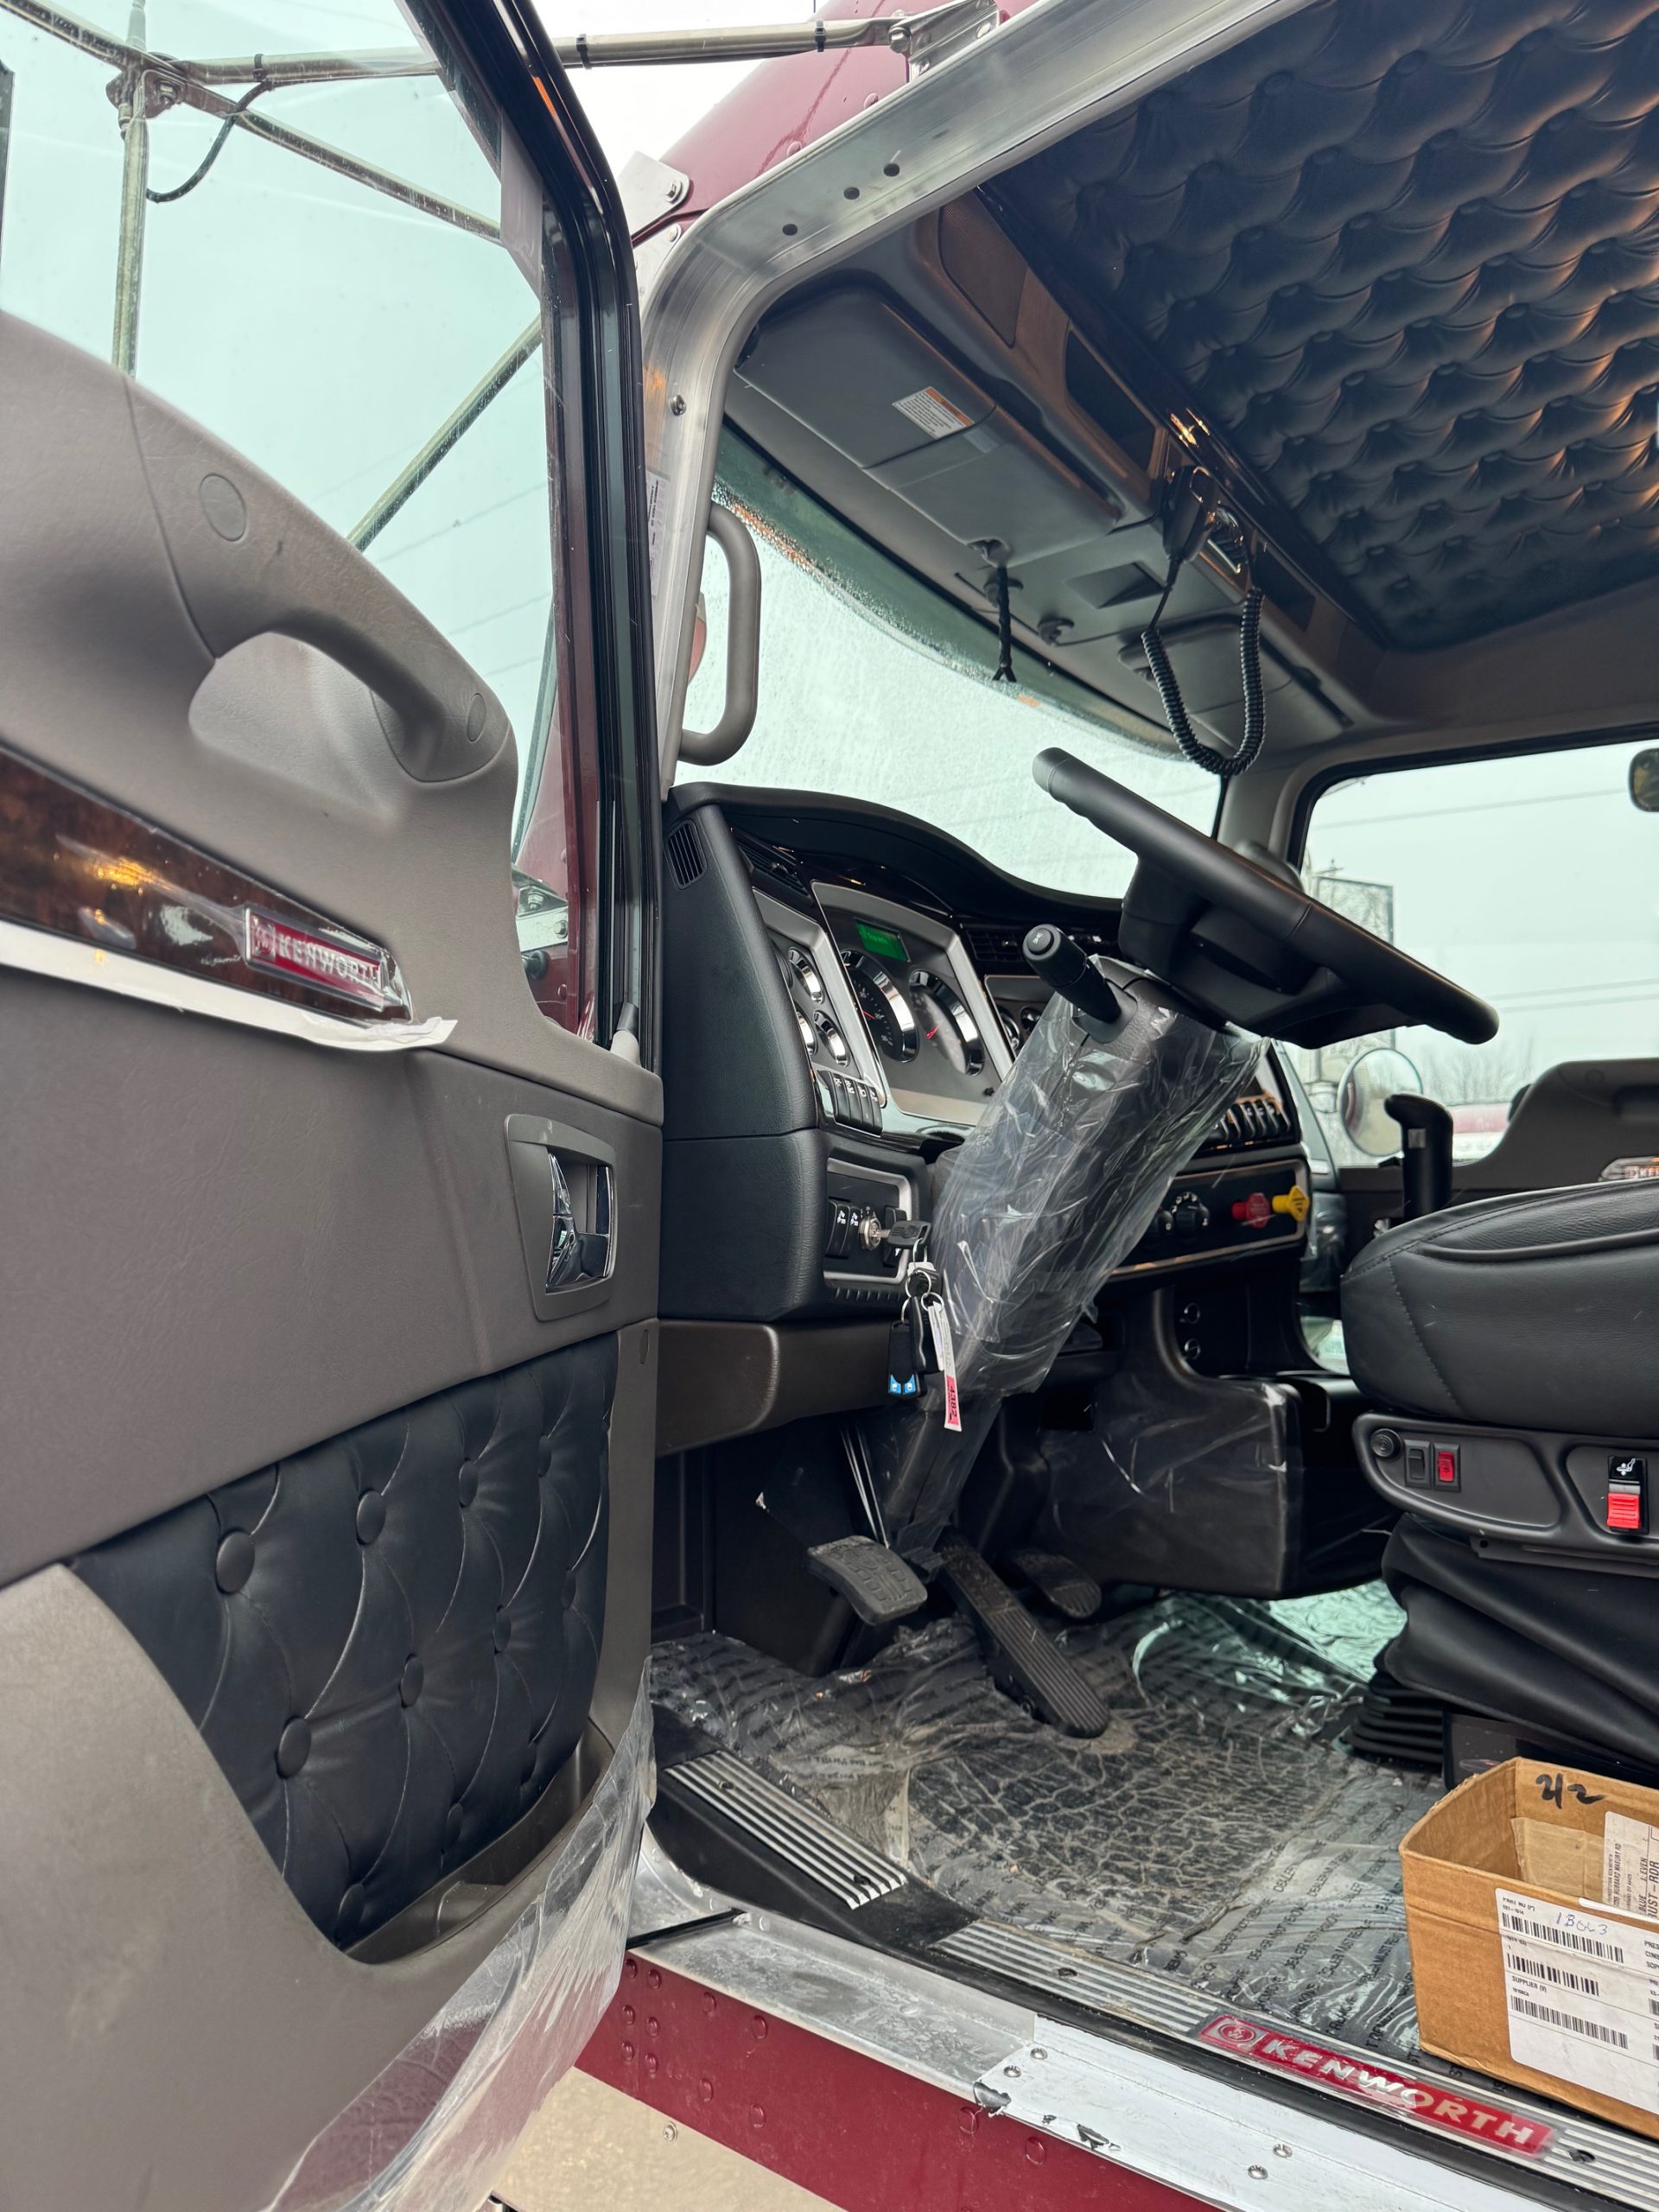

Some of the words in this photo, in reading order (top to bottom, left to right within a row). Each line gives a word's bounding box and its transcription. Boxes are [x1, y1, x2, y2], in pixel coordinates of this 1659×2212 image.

[1639, 1857, 1648, 1874] EVEN
[1512, 1976, 1538, 1989] SUPPLIER
[1260, 2038, 1534, 2145] KENWORTH
